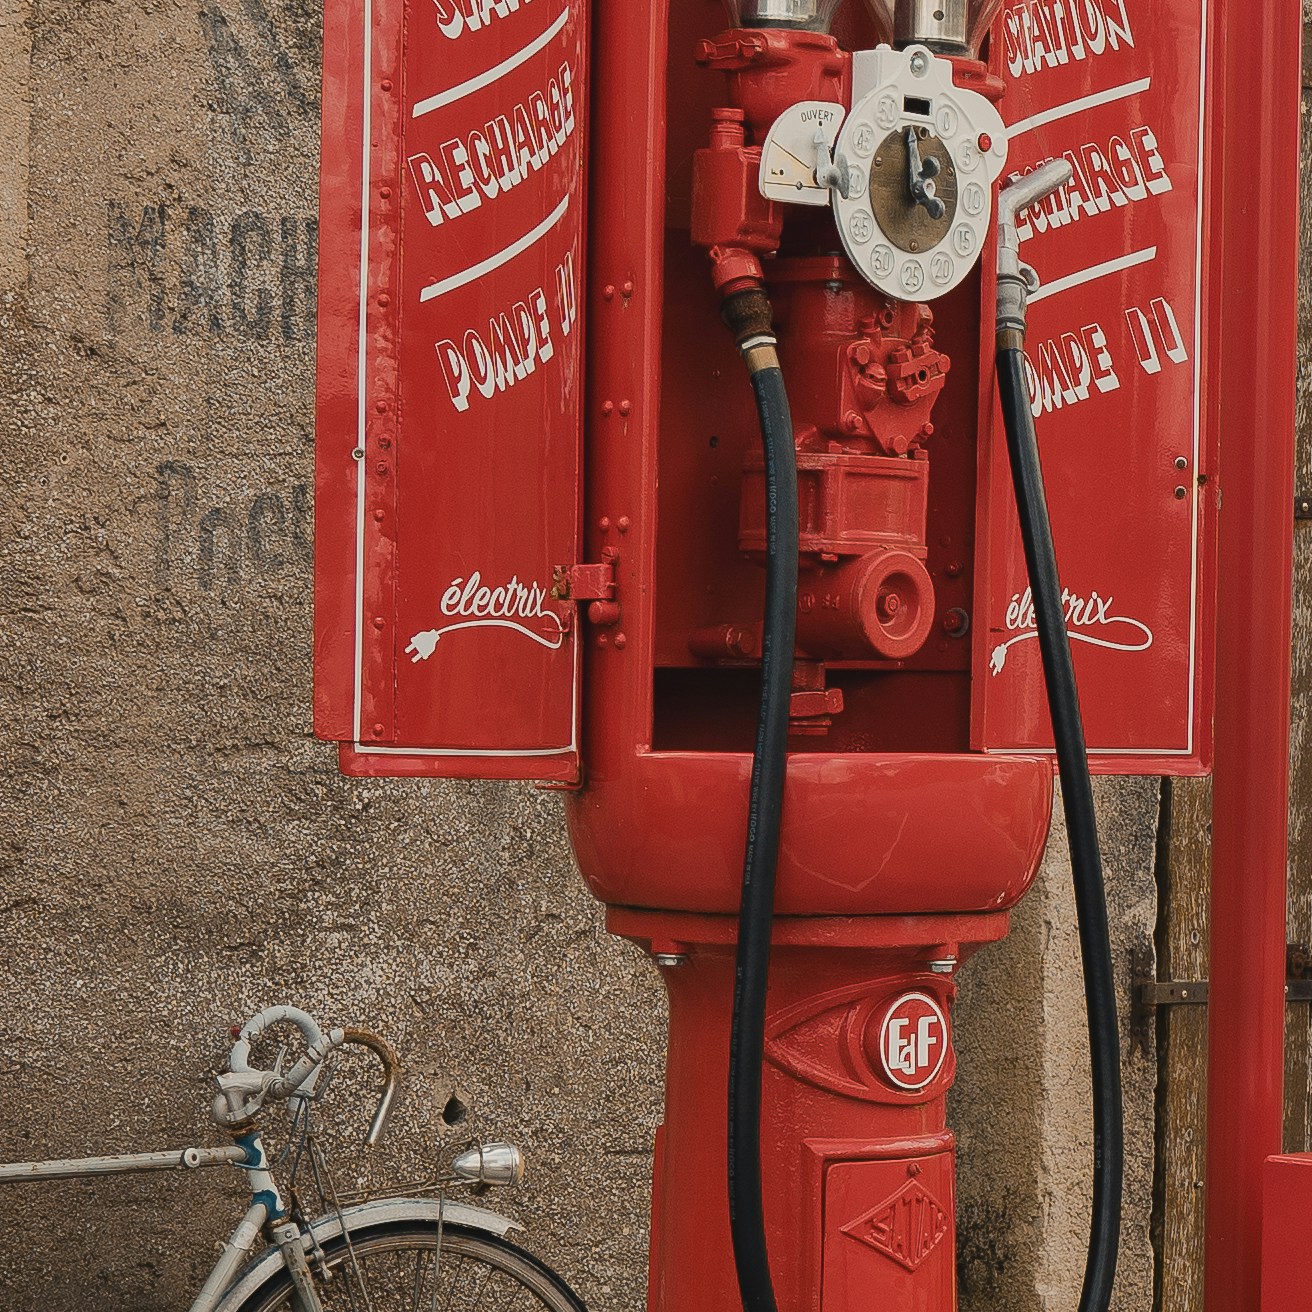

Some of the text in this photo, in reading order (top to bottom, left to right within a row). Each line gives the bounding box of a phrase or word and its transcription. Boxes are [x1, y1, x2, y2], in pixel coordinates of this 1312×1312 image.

[408, 61, 575, 227] RECHARGE
[800, 109, 834, 122] OUVERT
[435, 288, 554, 412] POMPE
